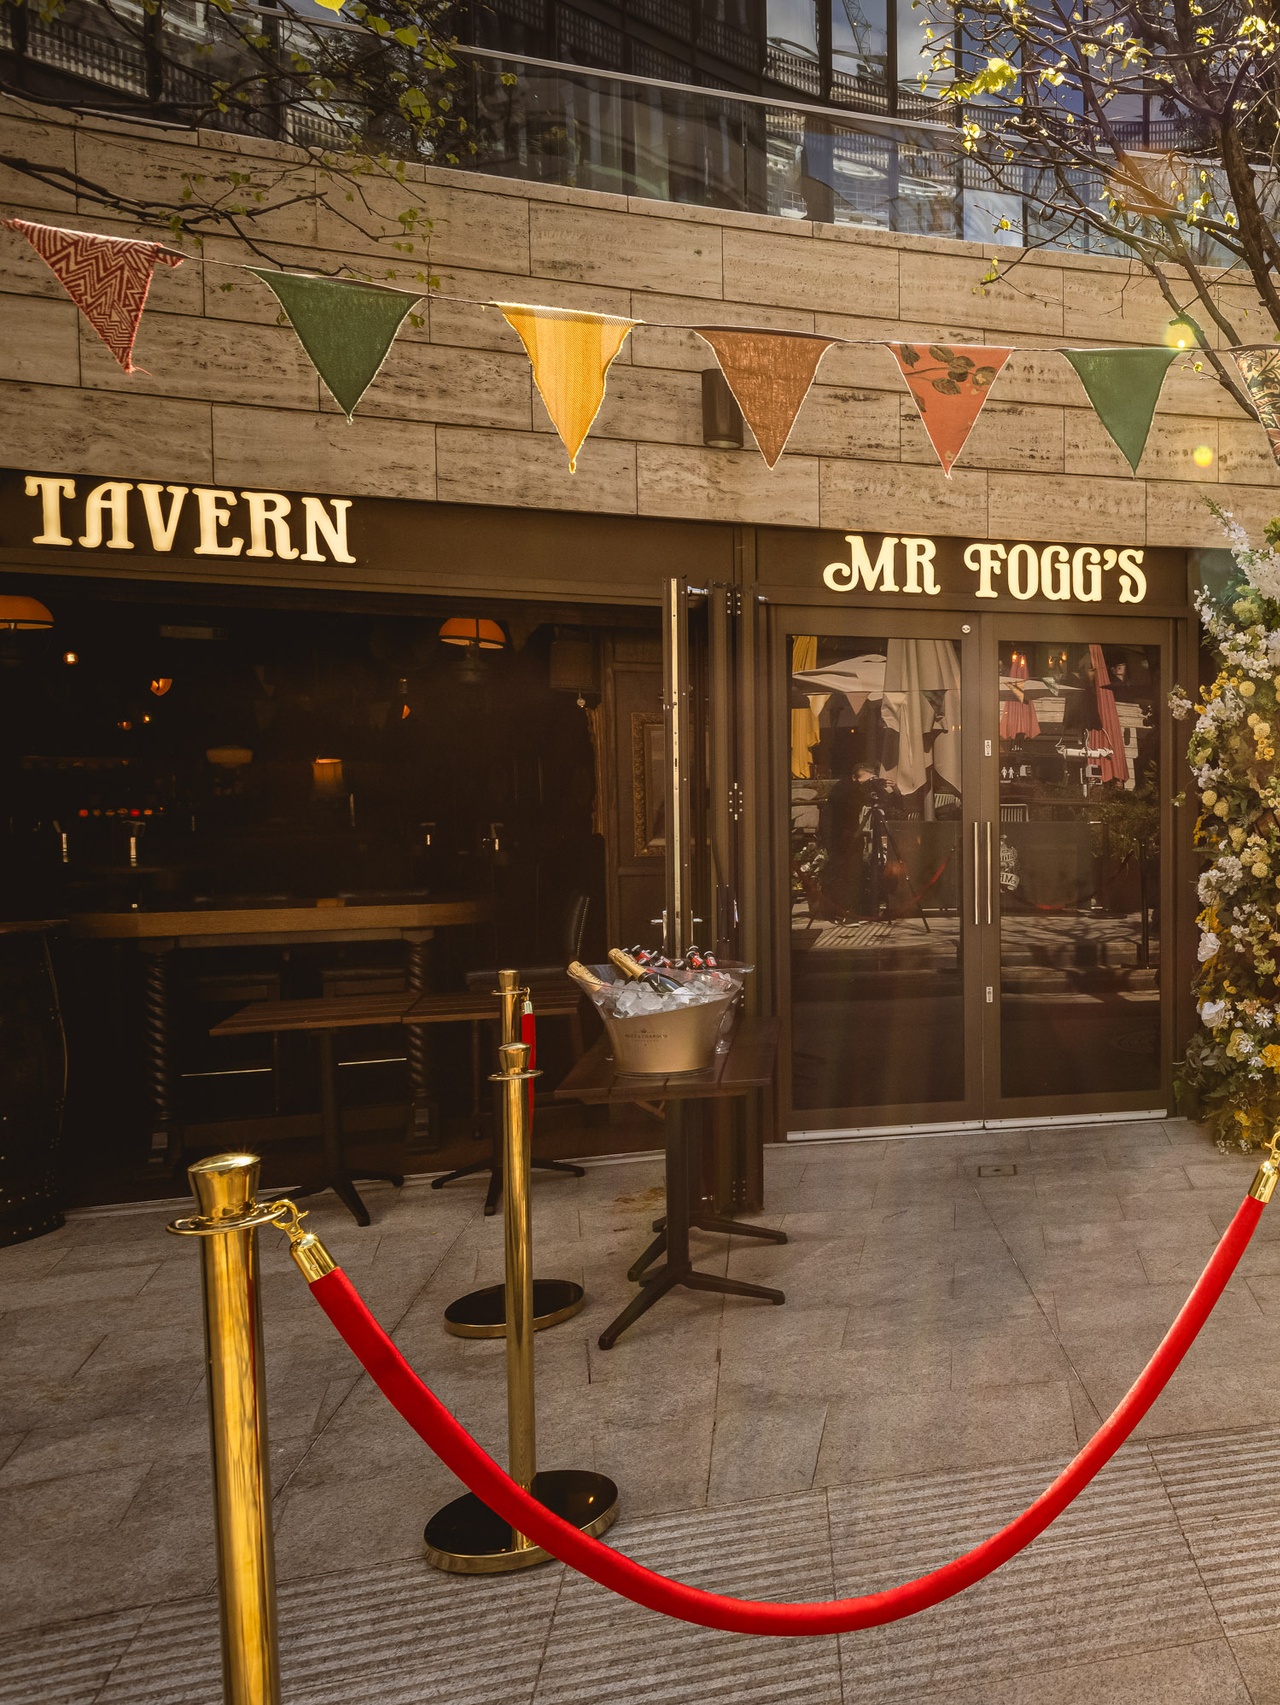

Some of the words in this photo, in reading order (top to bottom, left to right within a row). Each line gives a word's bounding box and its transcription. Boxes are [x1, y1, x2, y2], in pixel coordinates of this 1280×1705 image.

[25, 475, 356, 563] TAVERN
[823, 535, 941, 595] MR
[964, 543, 1147, 604] FOGG'S
